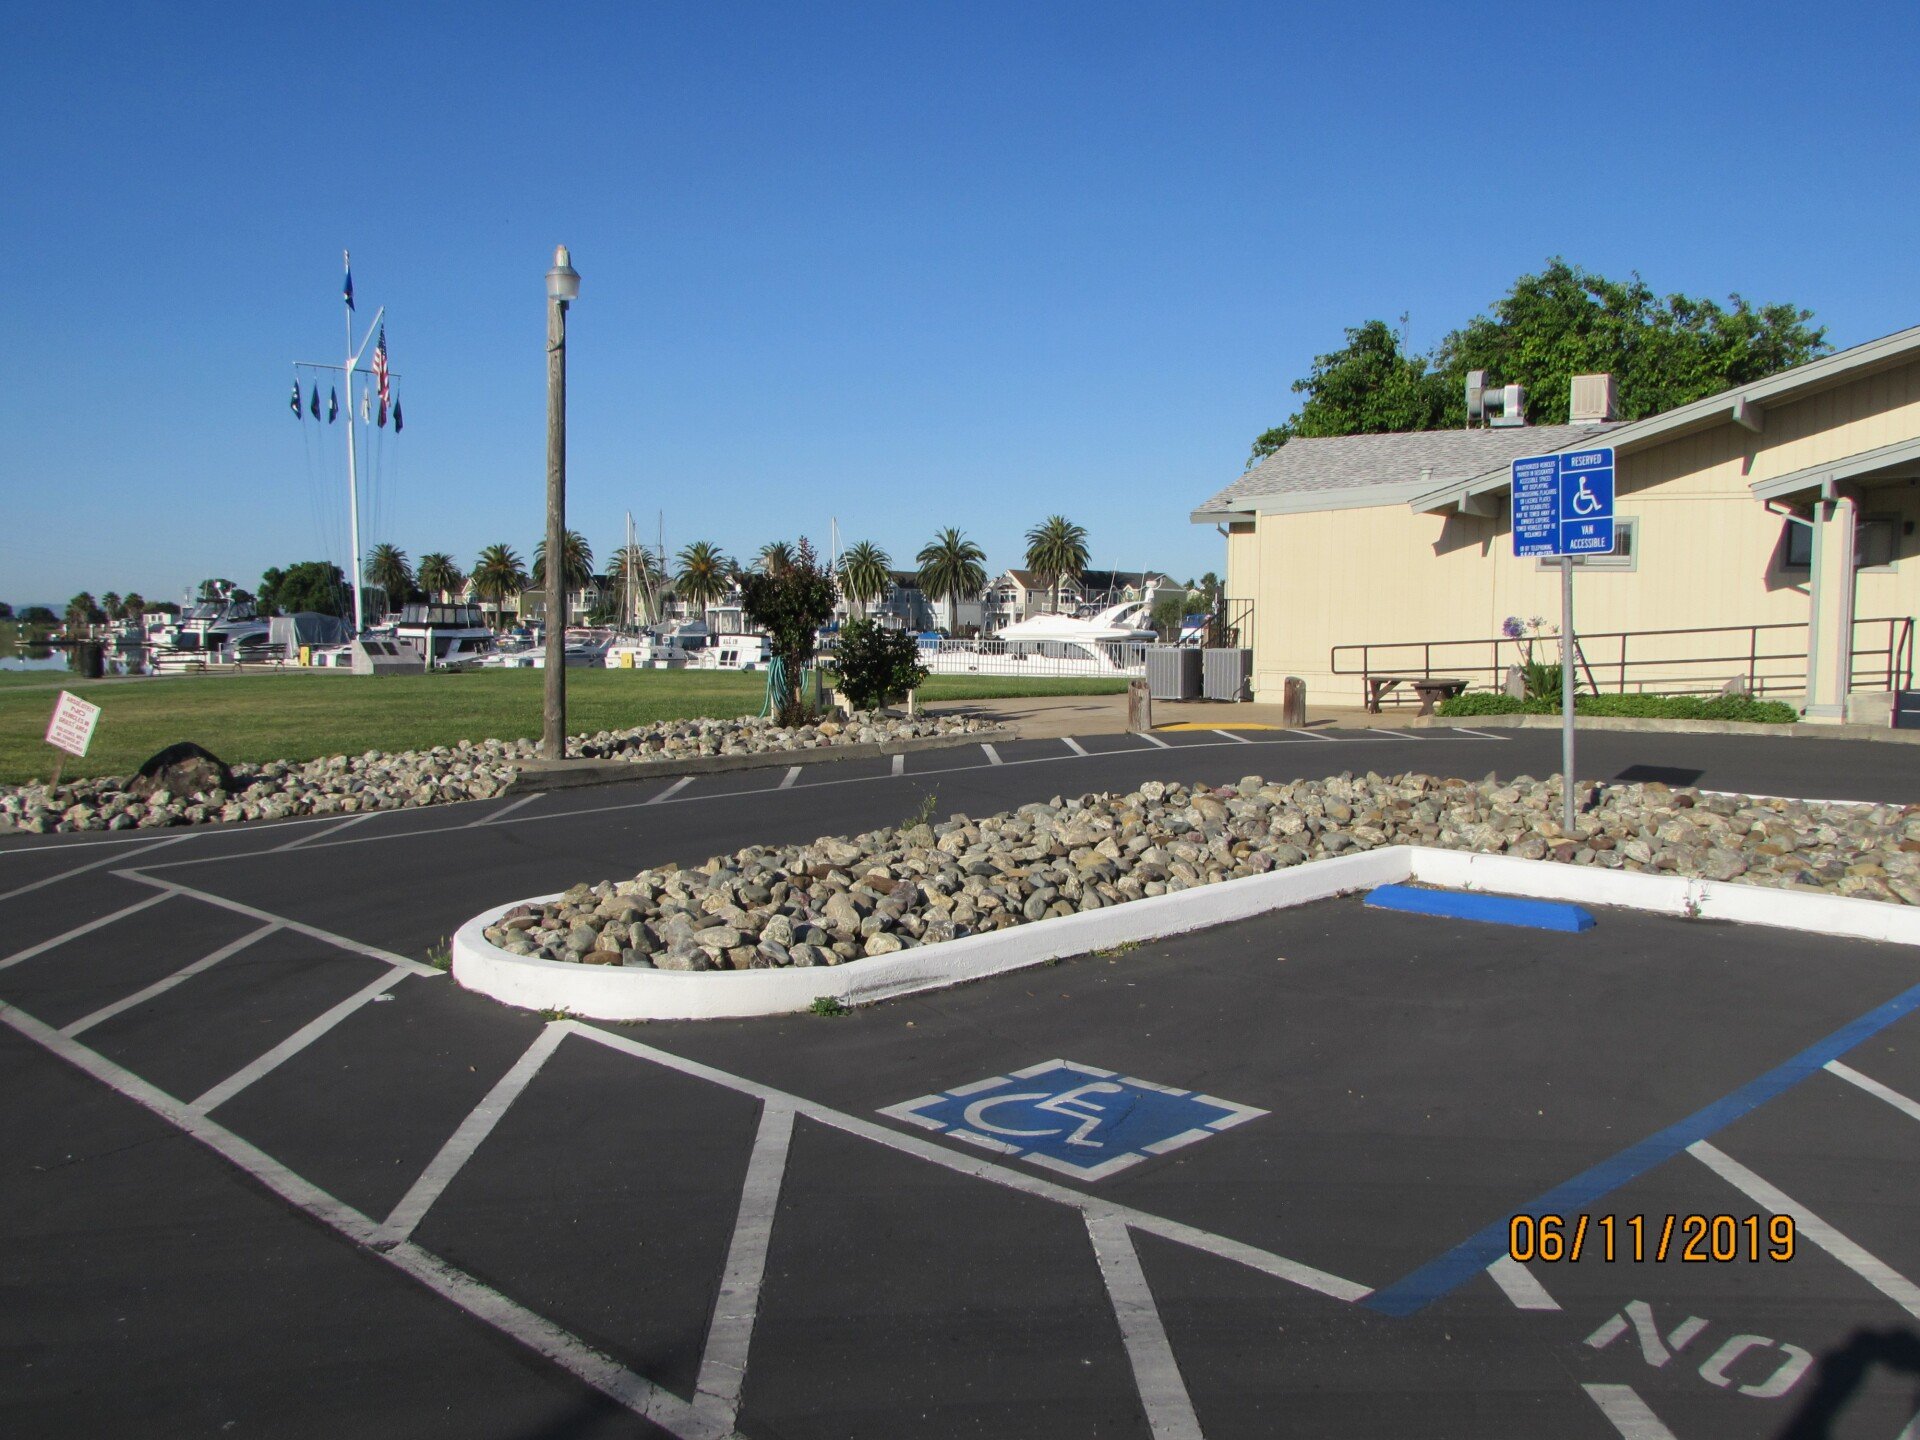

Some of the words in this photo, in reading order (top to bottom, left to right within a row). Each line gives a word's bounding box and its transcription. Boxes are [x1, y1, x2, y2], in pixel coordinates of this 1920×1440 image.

[1571, 454, 1601, 467] RESERVED
[1581, 525, 1593, 535] VAN
[1570, 537, 1605, 549] ACCESSIBLE
[70, 707, 86, 716] NO
[1583, 1299, 1814, 1398] NO
